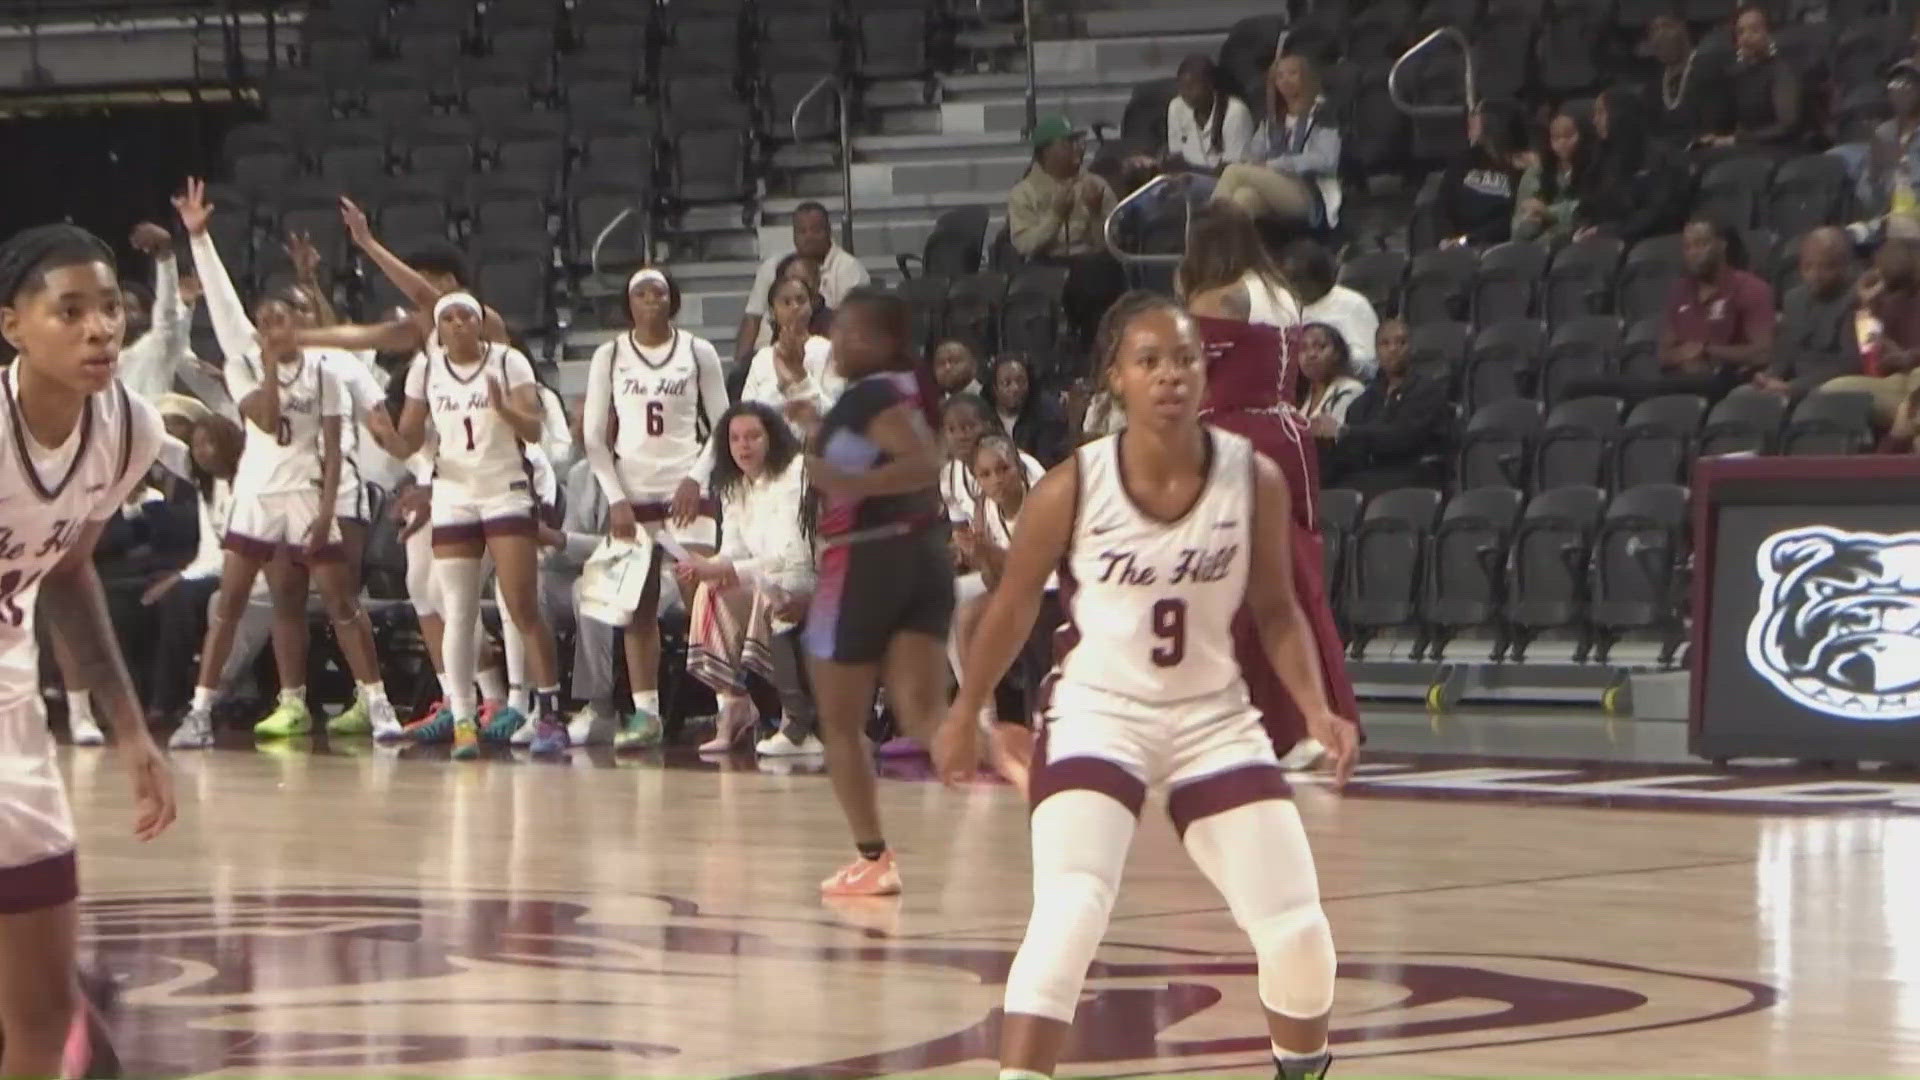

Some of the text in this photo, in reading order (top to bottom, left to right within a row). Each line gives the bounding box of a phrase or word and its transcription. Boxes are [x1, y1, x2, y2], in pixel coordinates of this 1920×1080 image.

[436, 395, 460, 412] The
[623, 378, 689, 396] The Hill
[463, 416, 475, 451] 1
[646, 401, 664, 437] 6
[1098, 544, 1239, 586] The Hill
[1152, 598, 1186, 668] 9
